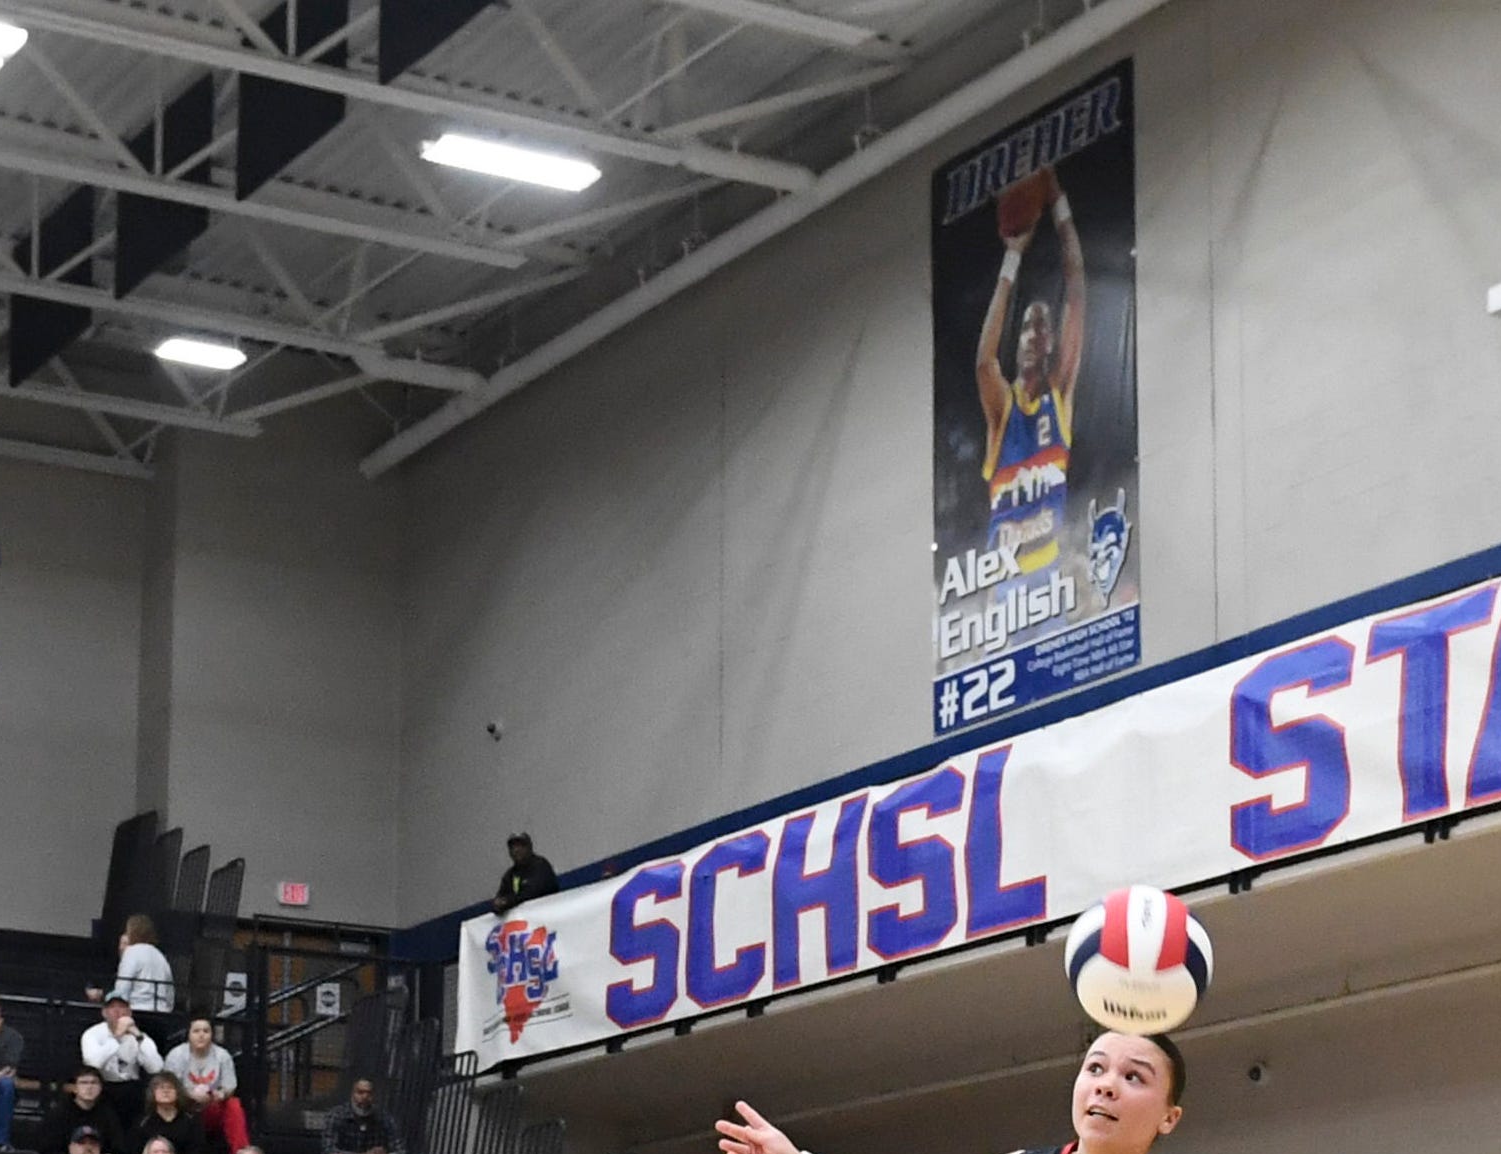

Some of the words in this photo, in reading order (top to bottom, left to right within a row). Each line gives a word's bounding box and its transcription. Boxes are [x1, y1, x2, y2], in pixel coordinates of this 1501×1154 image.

[939, 543, 1021, 604] Alex
[940, 571, 1075, 659] English
[939, 659, 1016, 728] #22
[605, 745, 1046, 1028] SCHSL
